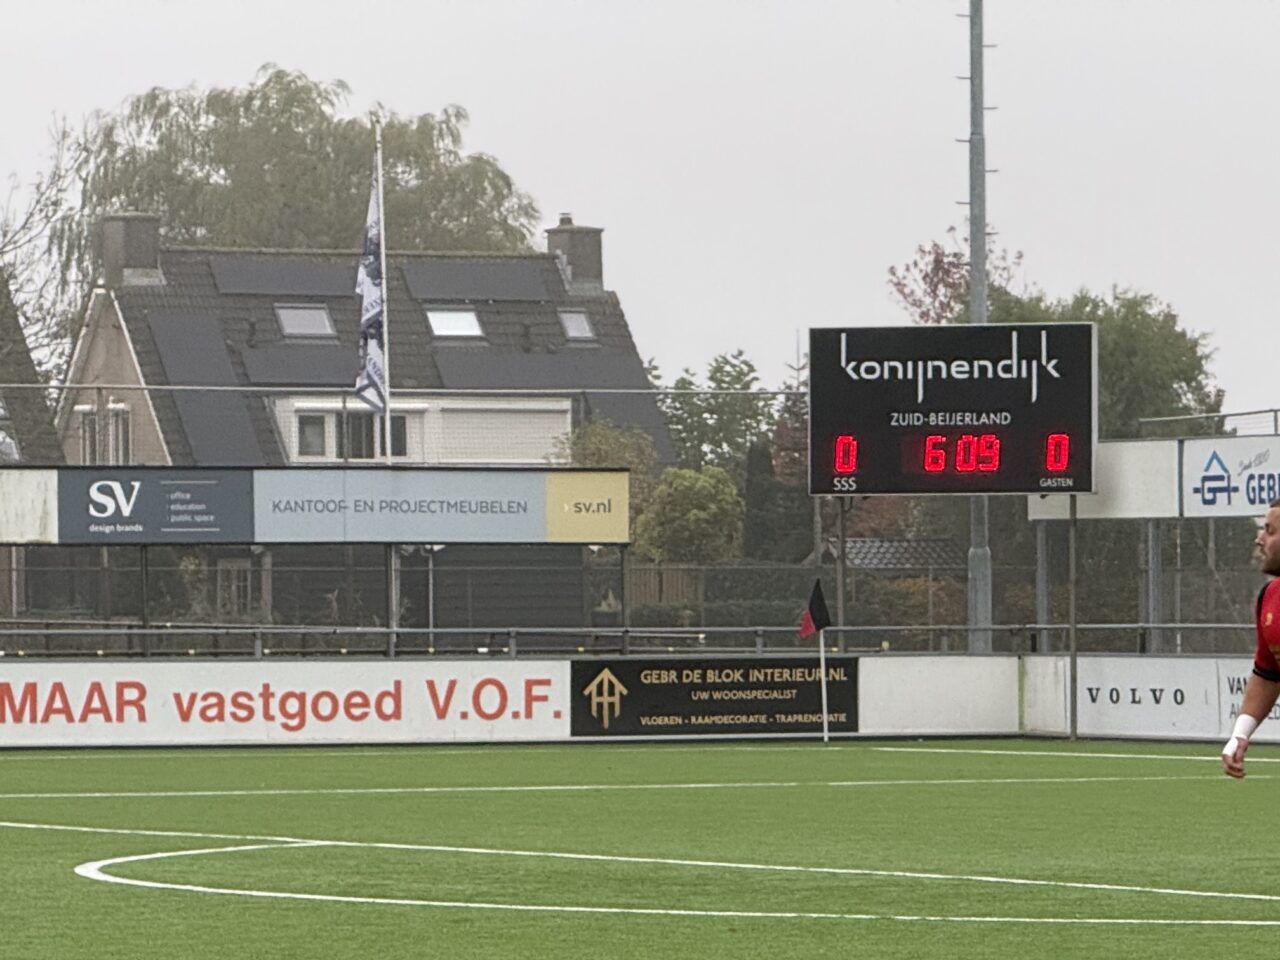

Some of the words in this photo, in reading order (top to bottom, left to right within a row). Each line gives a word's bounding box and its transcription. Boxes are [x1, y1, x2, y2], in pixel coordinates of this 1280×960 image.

[841, 330, 1061, 403] konijnendijk
[890, 412, 1012, 426] ZUID-BEIJERLAND
[834, 435, 858, 472] 0
[1046, 433, 1069, 471] 0
[833, 477, 857, 491] SSS
[1040, 477, 1073, 488] GASTEN
[89, 480, 142, 518] SV
[354, 499, 374, 513] EN
[379, 499, 528, 514] PROJECTMEUBELEN
[574, 499, 612, 514] sv.nl
[89, 523, 115, 534] design
[116, 523, 144, 533] brands
[640, 670, 679, 684] GEBR
[682, 670, 702, 683] DE
[706, 669, 744, 683] BLOK
[691, 691, 710, 700] UW
[711, 690, 797, 700] WOONSPECIALIST
[1087, 688, 1185, 705] VOLVO
[0, 681, 147, 724] MAAR
[173, 679, 403, 732] vastgoed
[426, 678, 562, 722] V.O.F.
[640, 716, 683, 726] VLOEREN
[691, 714, 767, 725] RAAMDECORATIE
[775, 713, 847, 723] TRAPRENOATIE
